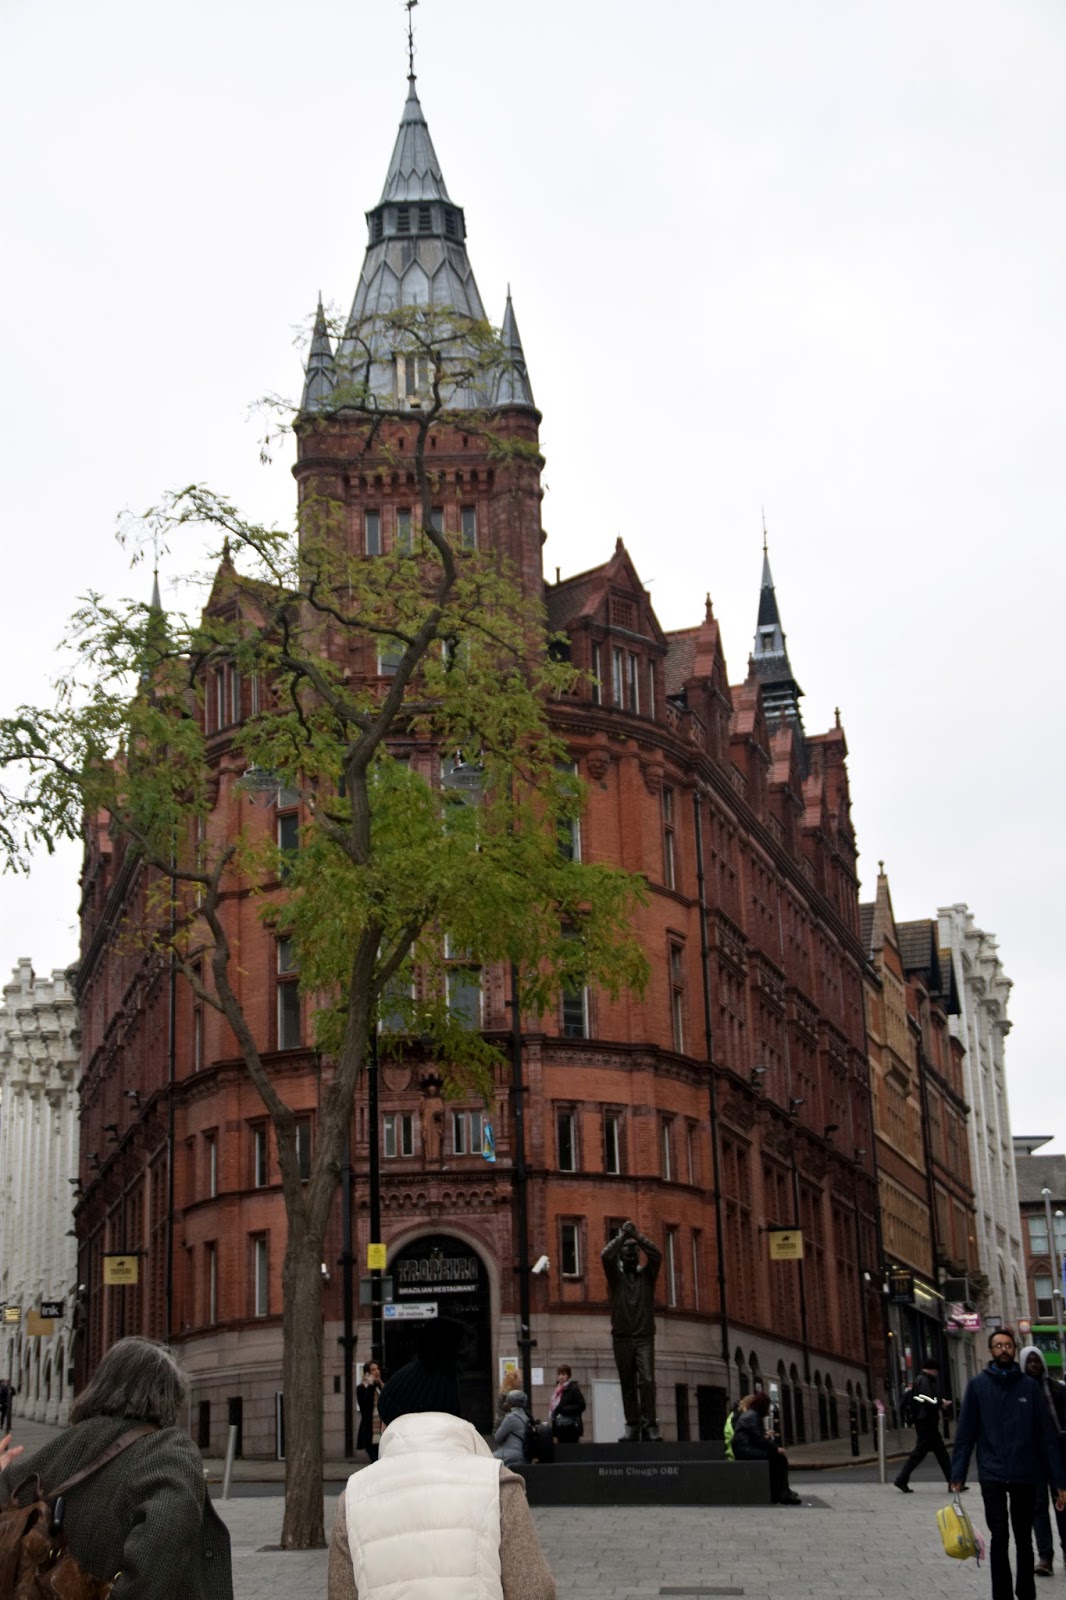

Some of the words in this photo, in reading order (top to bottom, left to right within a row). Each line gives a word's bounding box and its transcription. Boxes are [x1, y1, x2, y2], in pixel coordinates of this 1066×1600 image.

[398, 1258, 478, 1281] TROPEIRO
[433, 1285, 476, 1293] RESTAURANT
[599, 1467, 623, 1475] Brian
[626, 1466, 658, 1476] Clough
[661, 1466, 679, 1475] OBE
